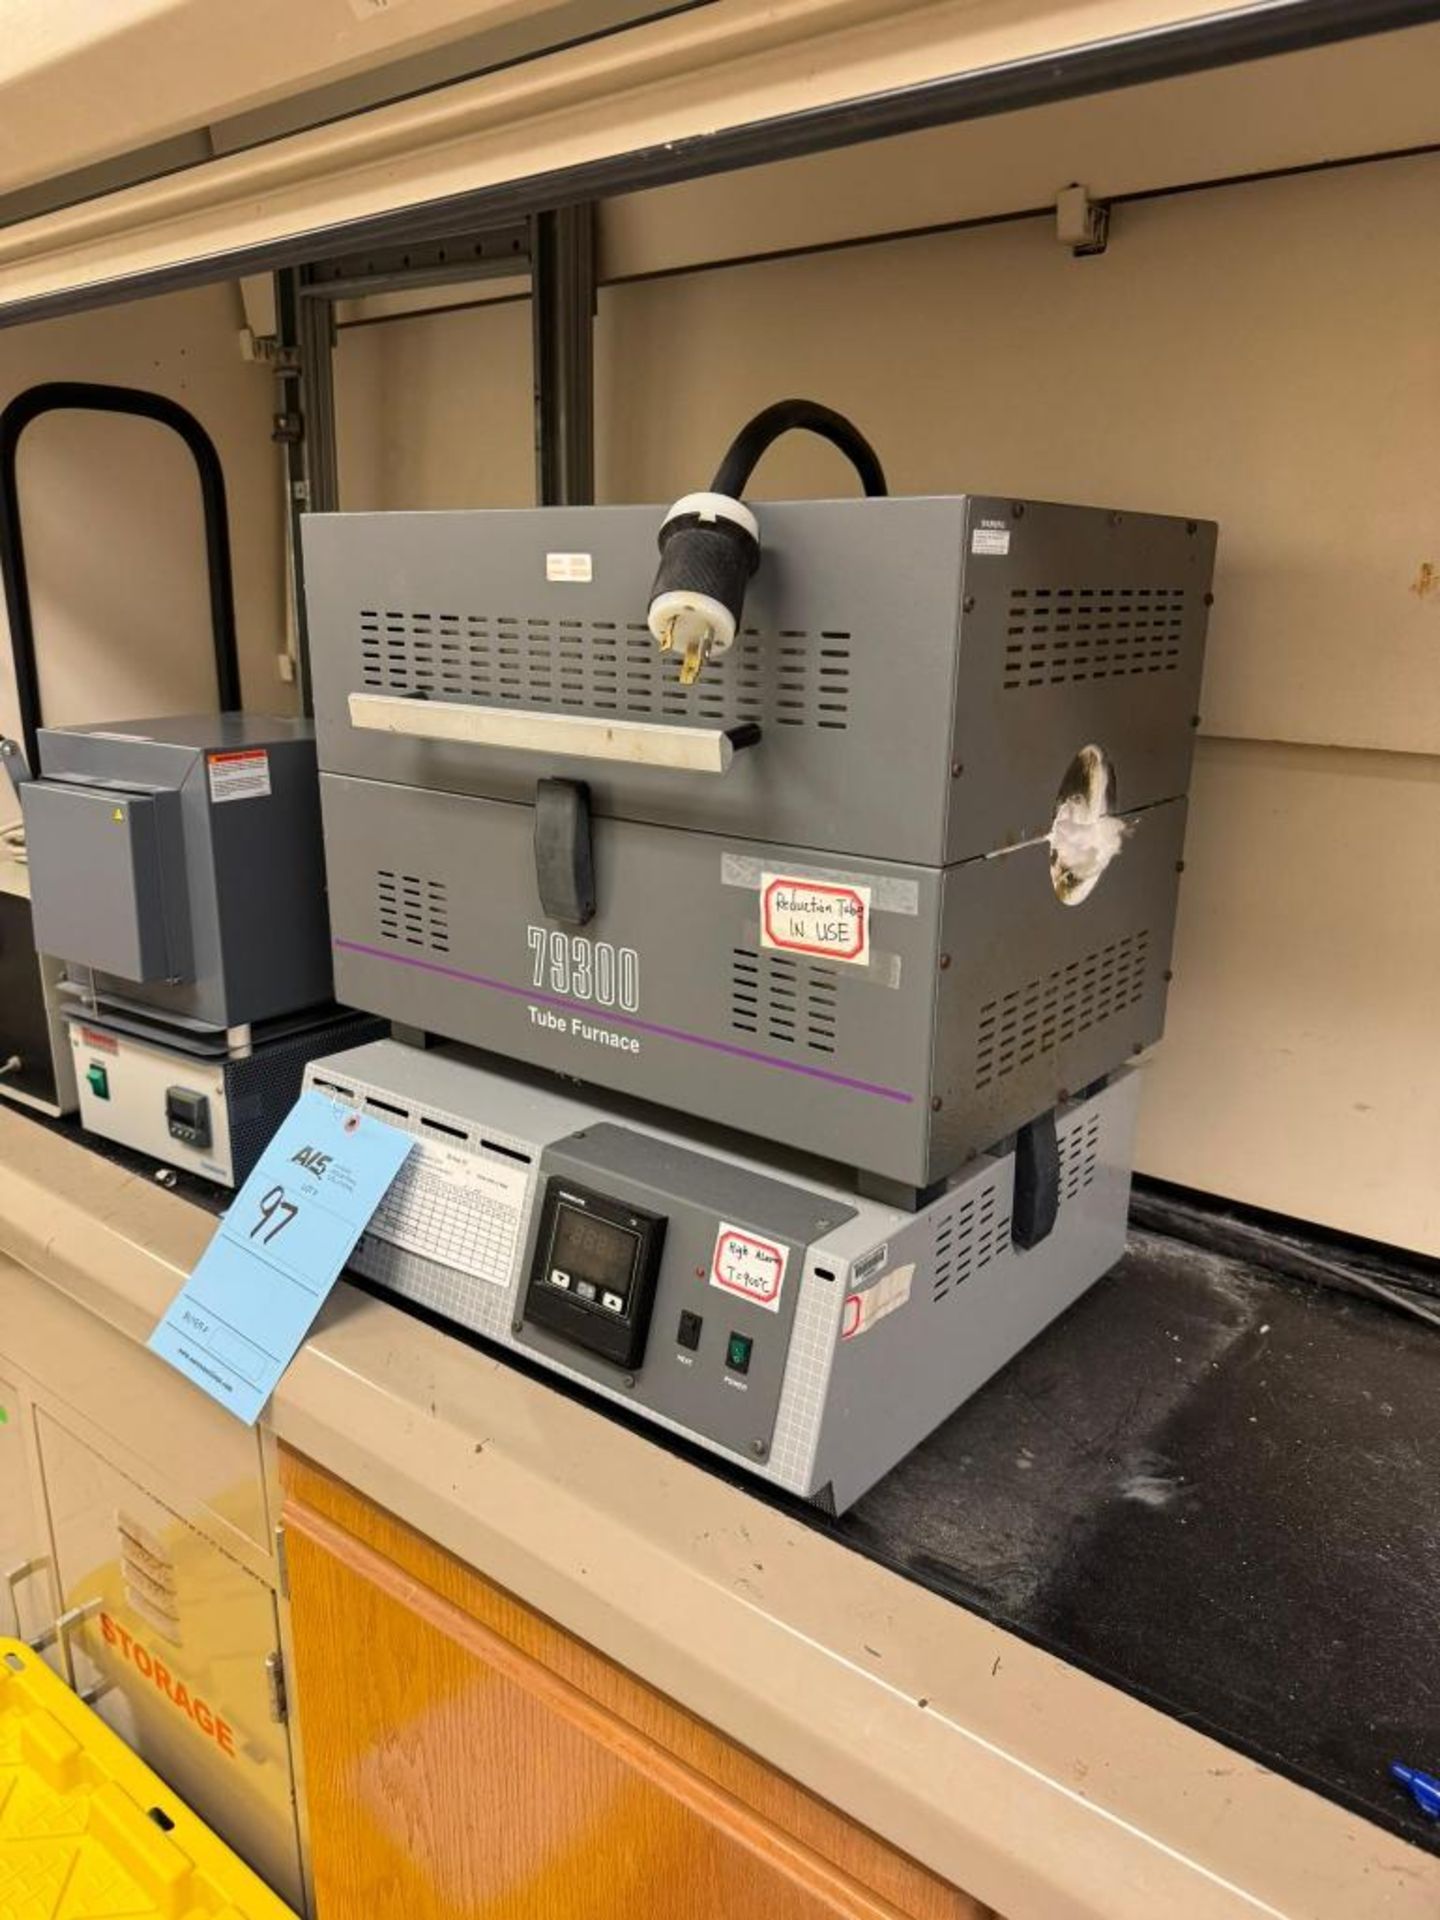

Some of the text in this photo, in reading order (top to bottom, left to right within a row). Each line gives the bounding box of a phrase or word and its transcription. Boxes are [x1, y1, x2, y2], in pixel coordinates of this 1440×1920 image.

[776, 889, 832, 914] Reduction
[789, 917, 851, 942] IN USE
[527, 925, 640, 1013] 79300
[527, 1005, 640, 1054] Tube Furnace
[250, 1185, 299, 1245] 97
[100, 1612, 236, 1759] STORAGE
